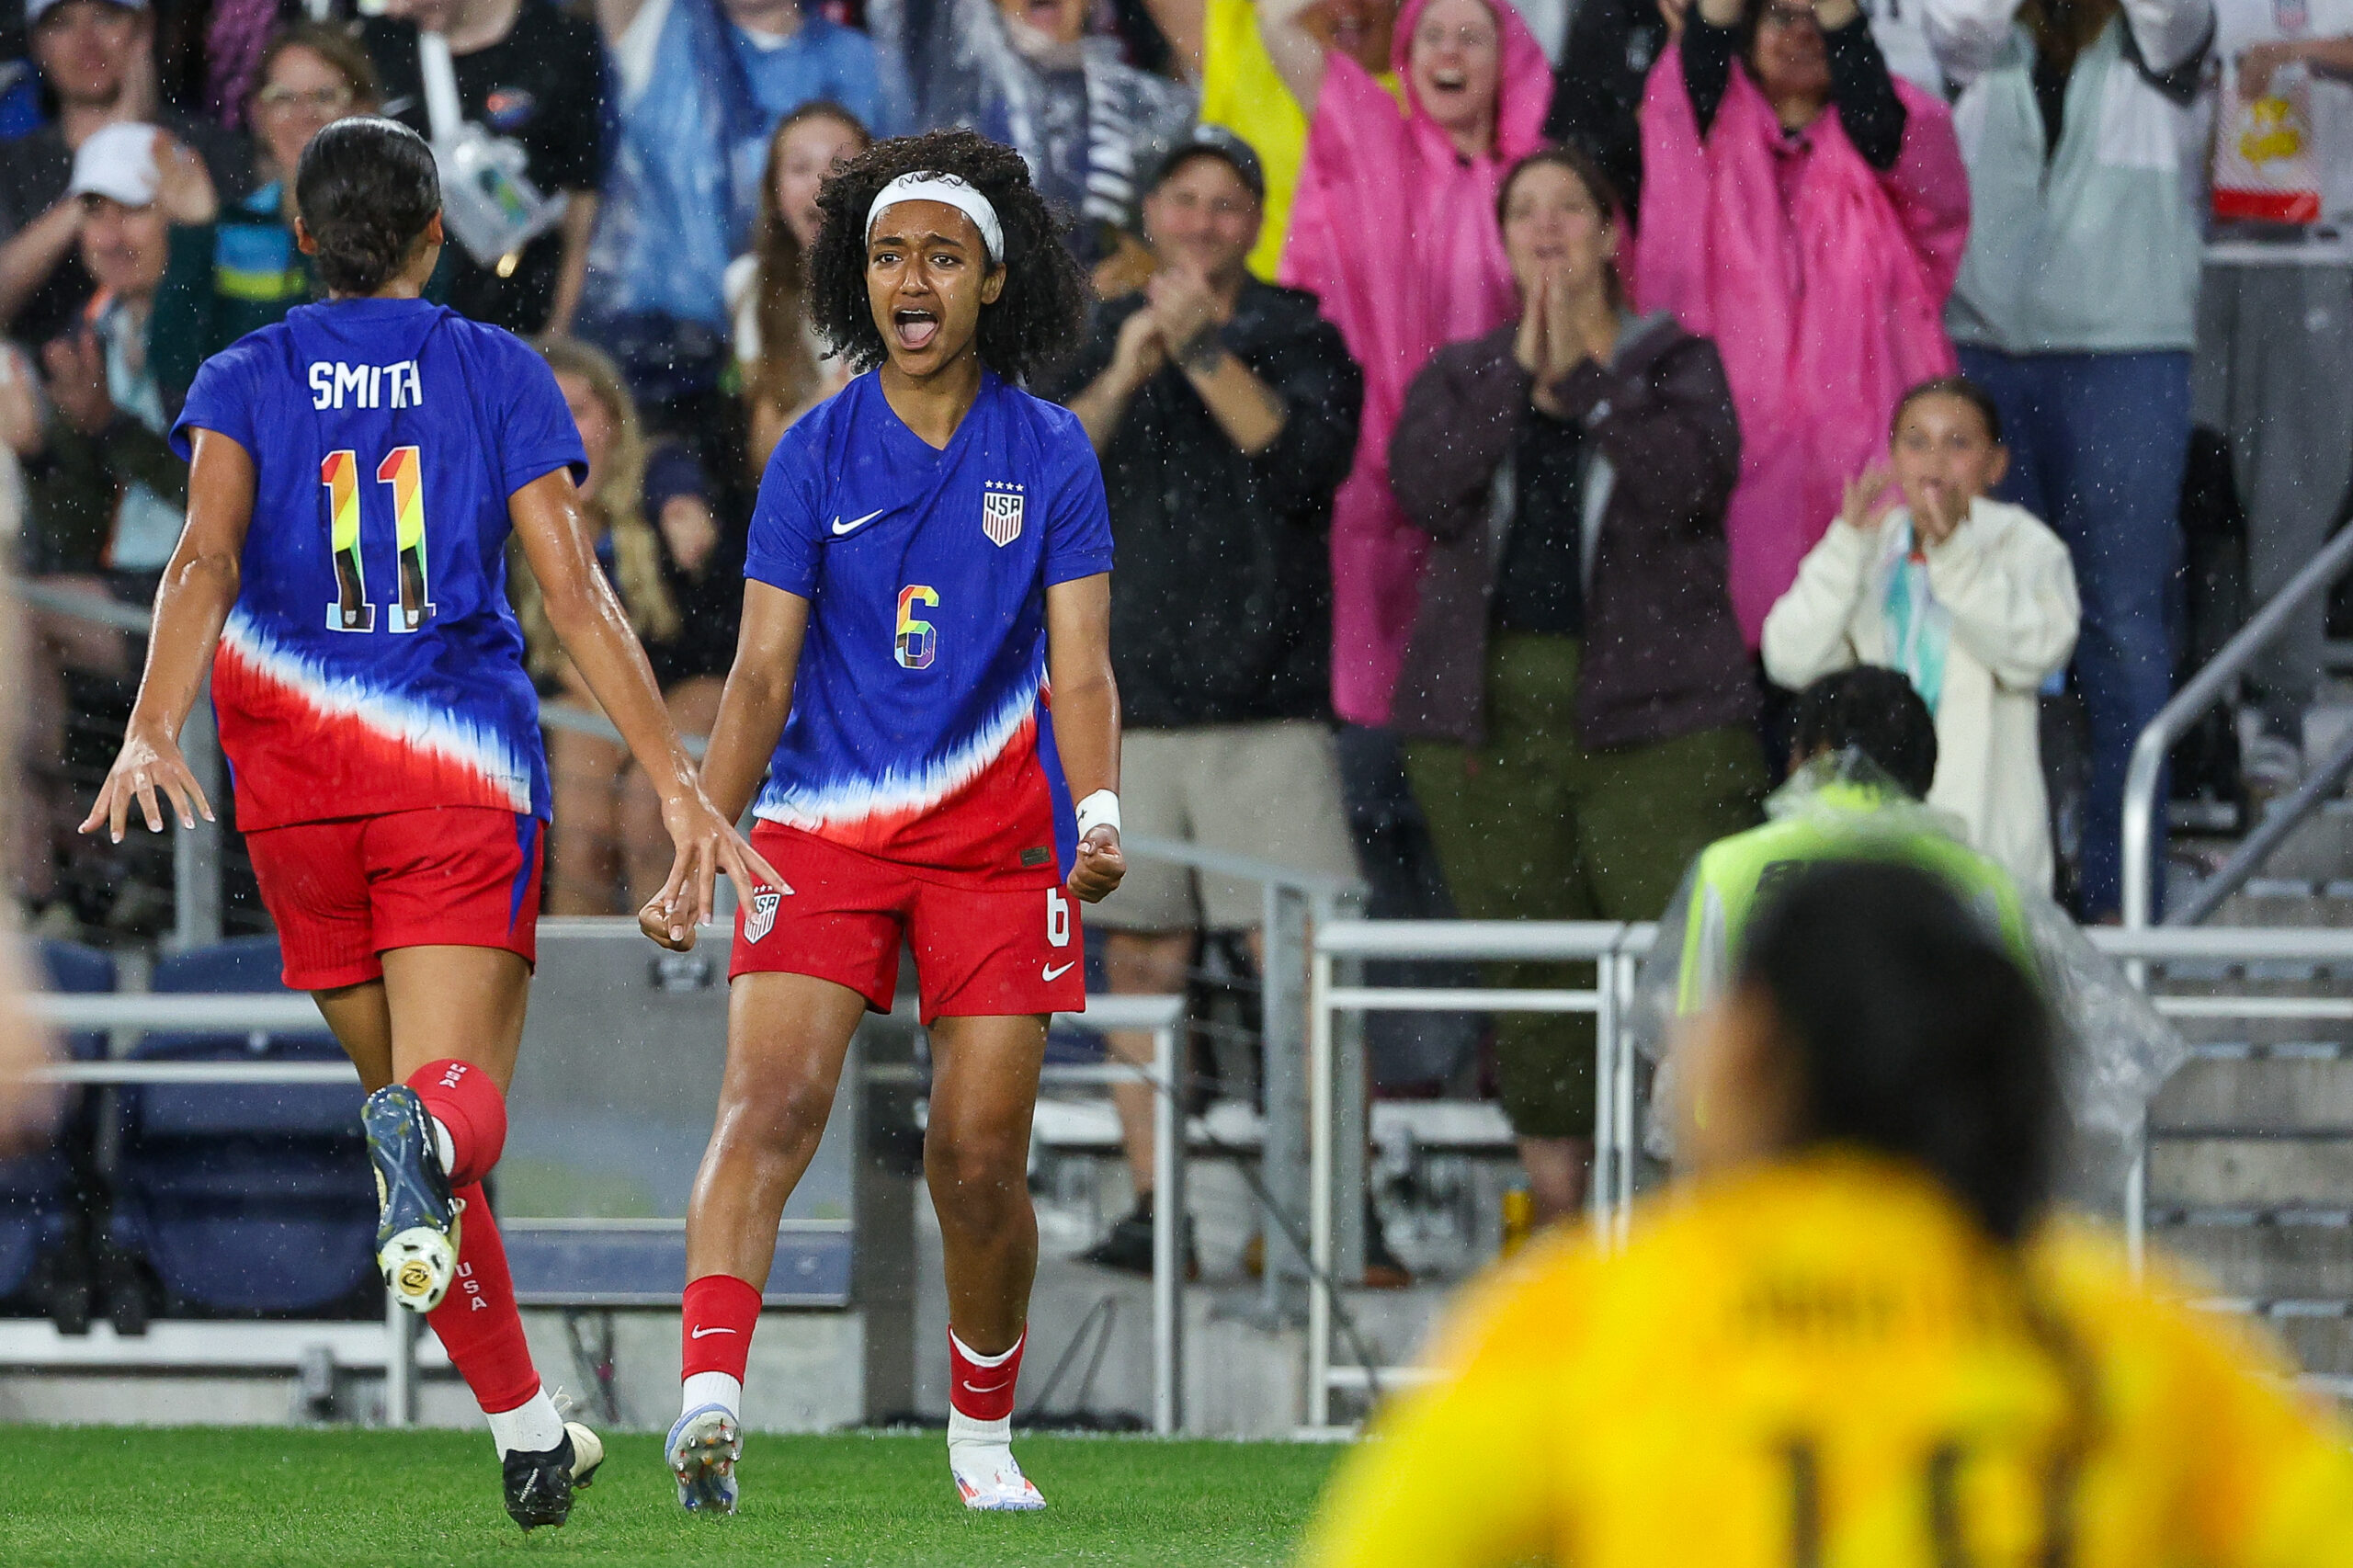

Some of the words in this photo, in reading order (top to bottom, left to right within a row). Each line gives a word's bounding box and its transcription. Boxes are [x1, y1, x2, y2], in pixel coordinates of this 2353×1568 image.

[309, 359, 423, 410] SMITH
[986, 494, 1021, 517] USA
[321, 446, 437, 633] 11
[894, 585, 939, 669] 6
[754, 895, 779, 915] SA
[1046, 887, 1071, 948] 6
[438, 1062, 468, 1089] USA
[455, 1261, 488, 1312] USA
